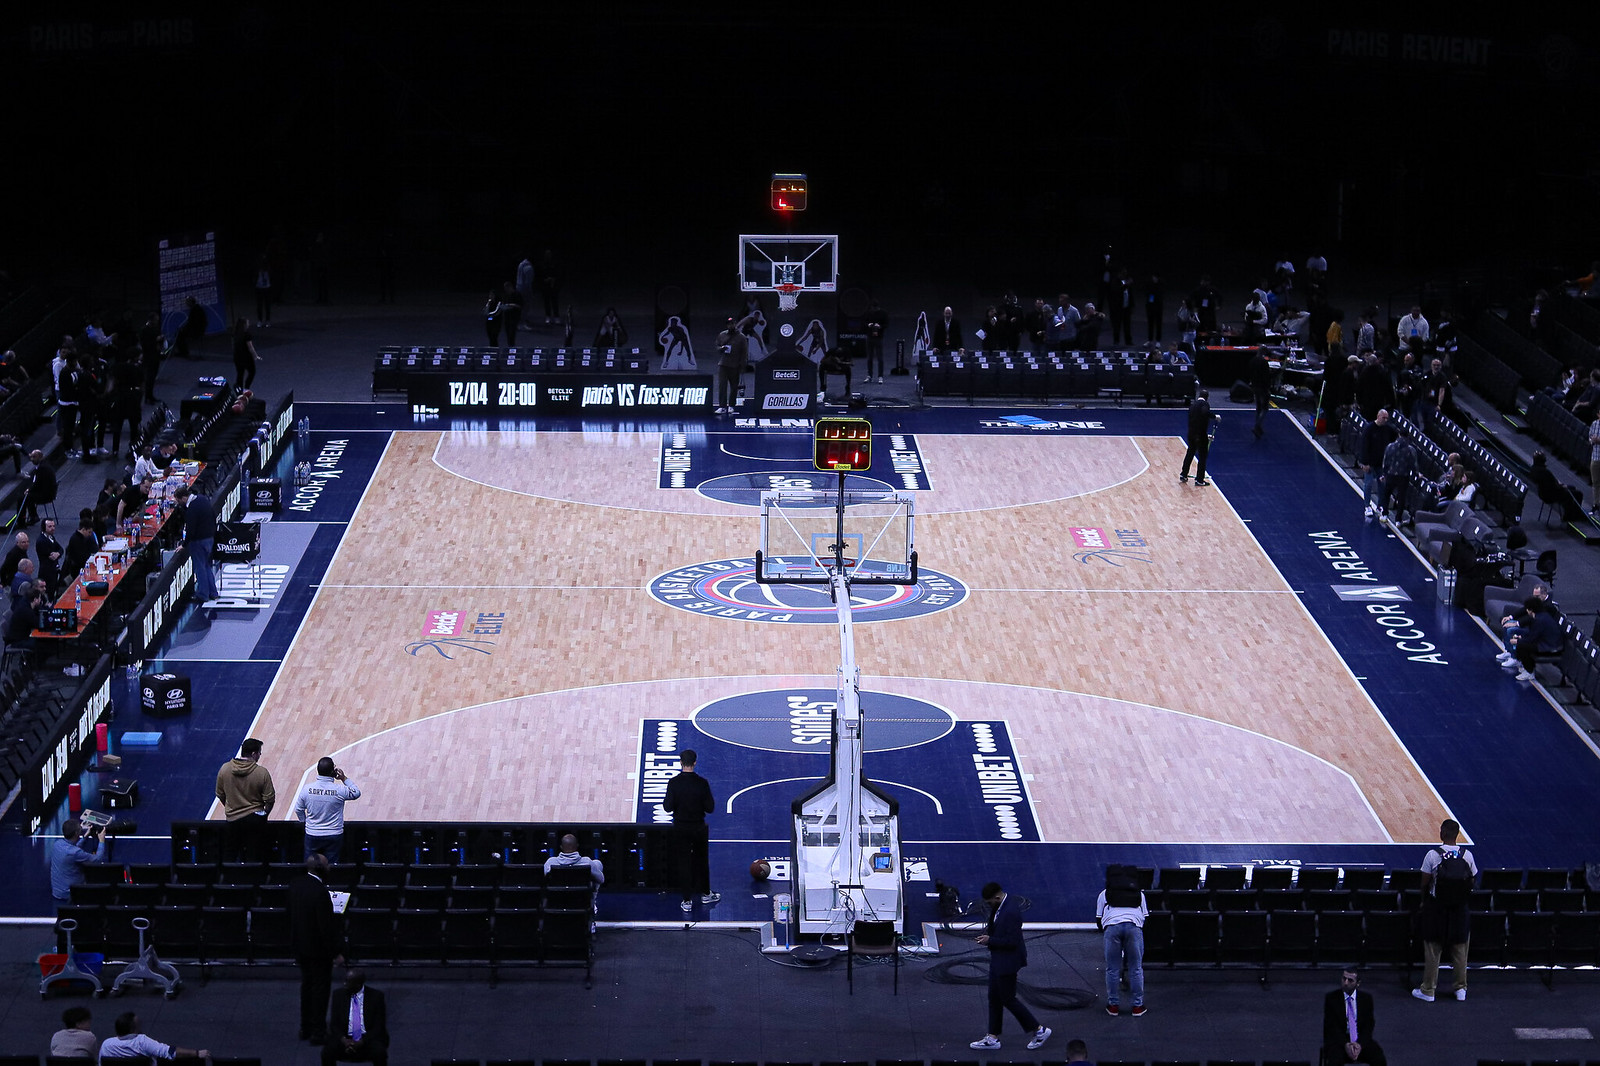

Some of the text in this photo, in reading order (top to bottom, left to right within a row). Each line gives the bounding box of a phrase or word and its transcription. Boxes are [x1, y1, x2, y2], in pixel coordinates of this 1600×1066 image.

[29, 23, 94, 50] PARIS
[132, 18, 193, 46] PARIS
[1327, 29, 1492, 65] PARIS REVIENT
[449, 382, 536, 405] 12/04 20:00
[581, 383, 708, 407] paris VS fos-sur-mer
[768, 397, 804, 407] GORILLAS
[759, 418, 815, 427] LN
[664, 448, 692, 472] UNIBET
[889, 449, 922, 474] UNIBET
[288, 438, 350, 512] ACCOR ARENA
[216, 543, 251, 552] SPALDING
[1307, 530, 1379, 582] ARENA
[201, 564, 290, 609] PARIS
[683, 600, 794, 622] PARIS
[1366, 604, 1449, 665] ACCOR
[972, 753, 1024, 804] UNIBET
